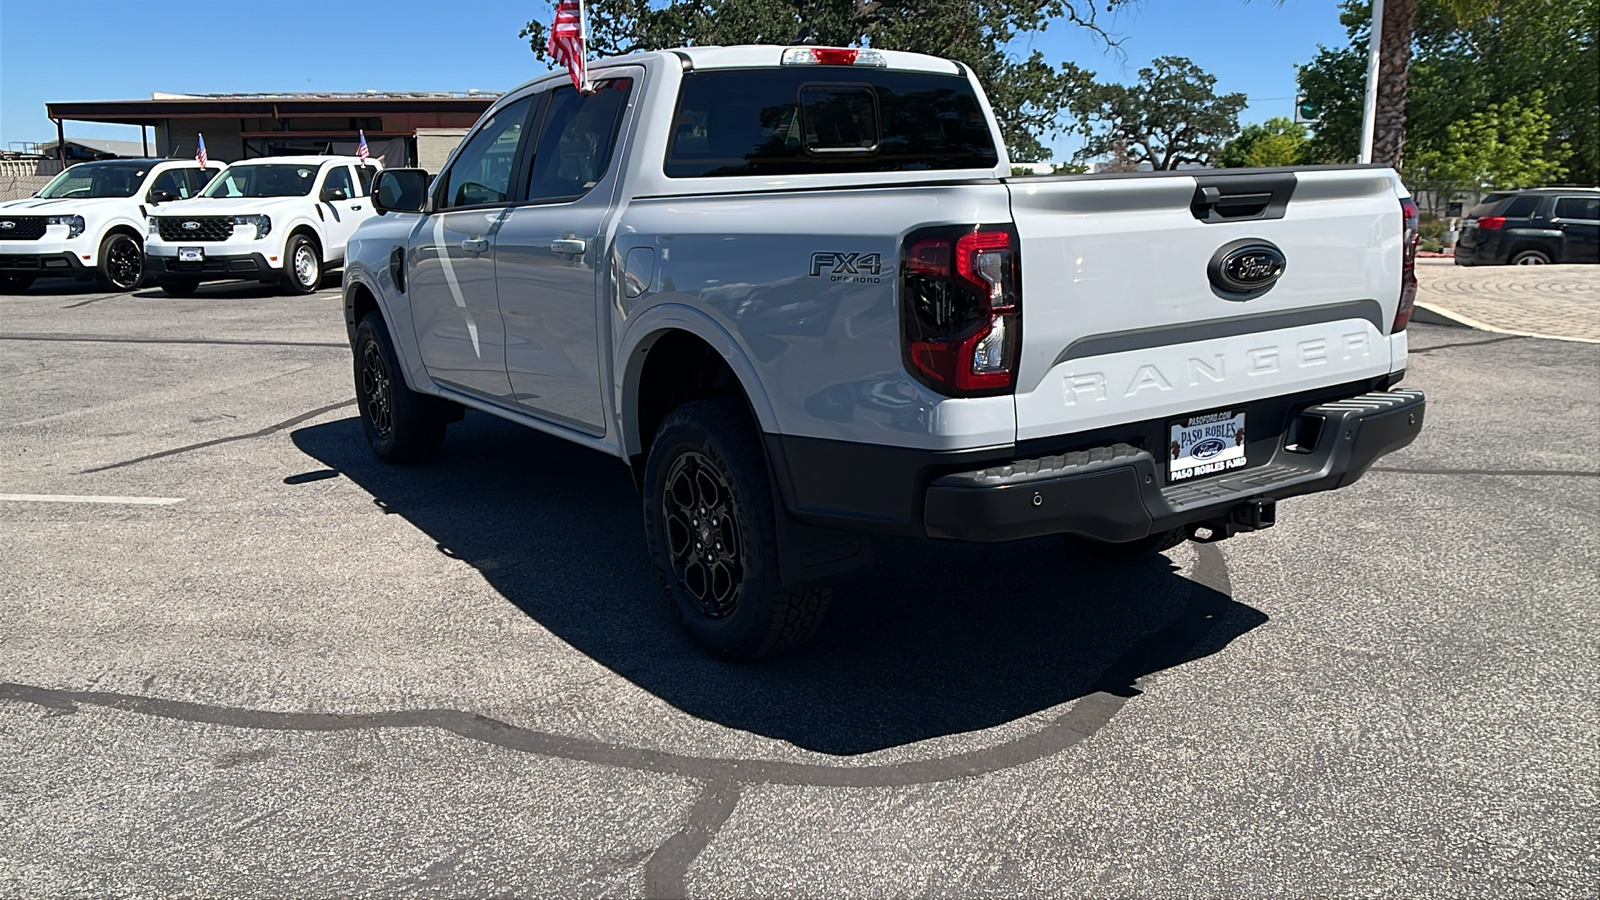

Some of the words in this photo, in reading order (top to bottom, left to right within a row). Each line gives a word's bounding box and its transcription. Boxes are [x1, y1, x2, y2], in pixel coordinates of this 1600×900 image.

[809, 252, 882, 277] FX4
[1238, 255, 1274, 279] Ford
[852, 276, 880, 284] ROAD
[1063, 330, 1370, 407] RANGER
[1188, 411, 1232, 426] PASOFORD.COM
[1181, 429, 1202, 448] PASO
[1205, 422, 1236, 438] ROBLES
[1197, 442, 1219, 458] Ford
[1171, 468, 1193, 481] PASO
[1194, 462, 1225, 475] ROBLES
